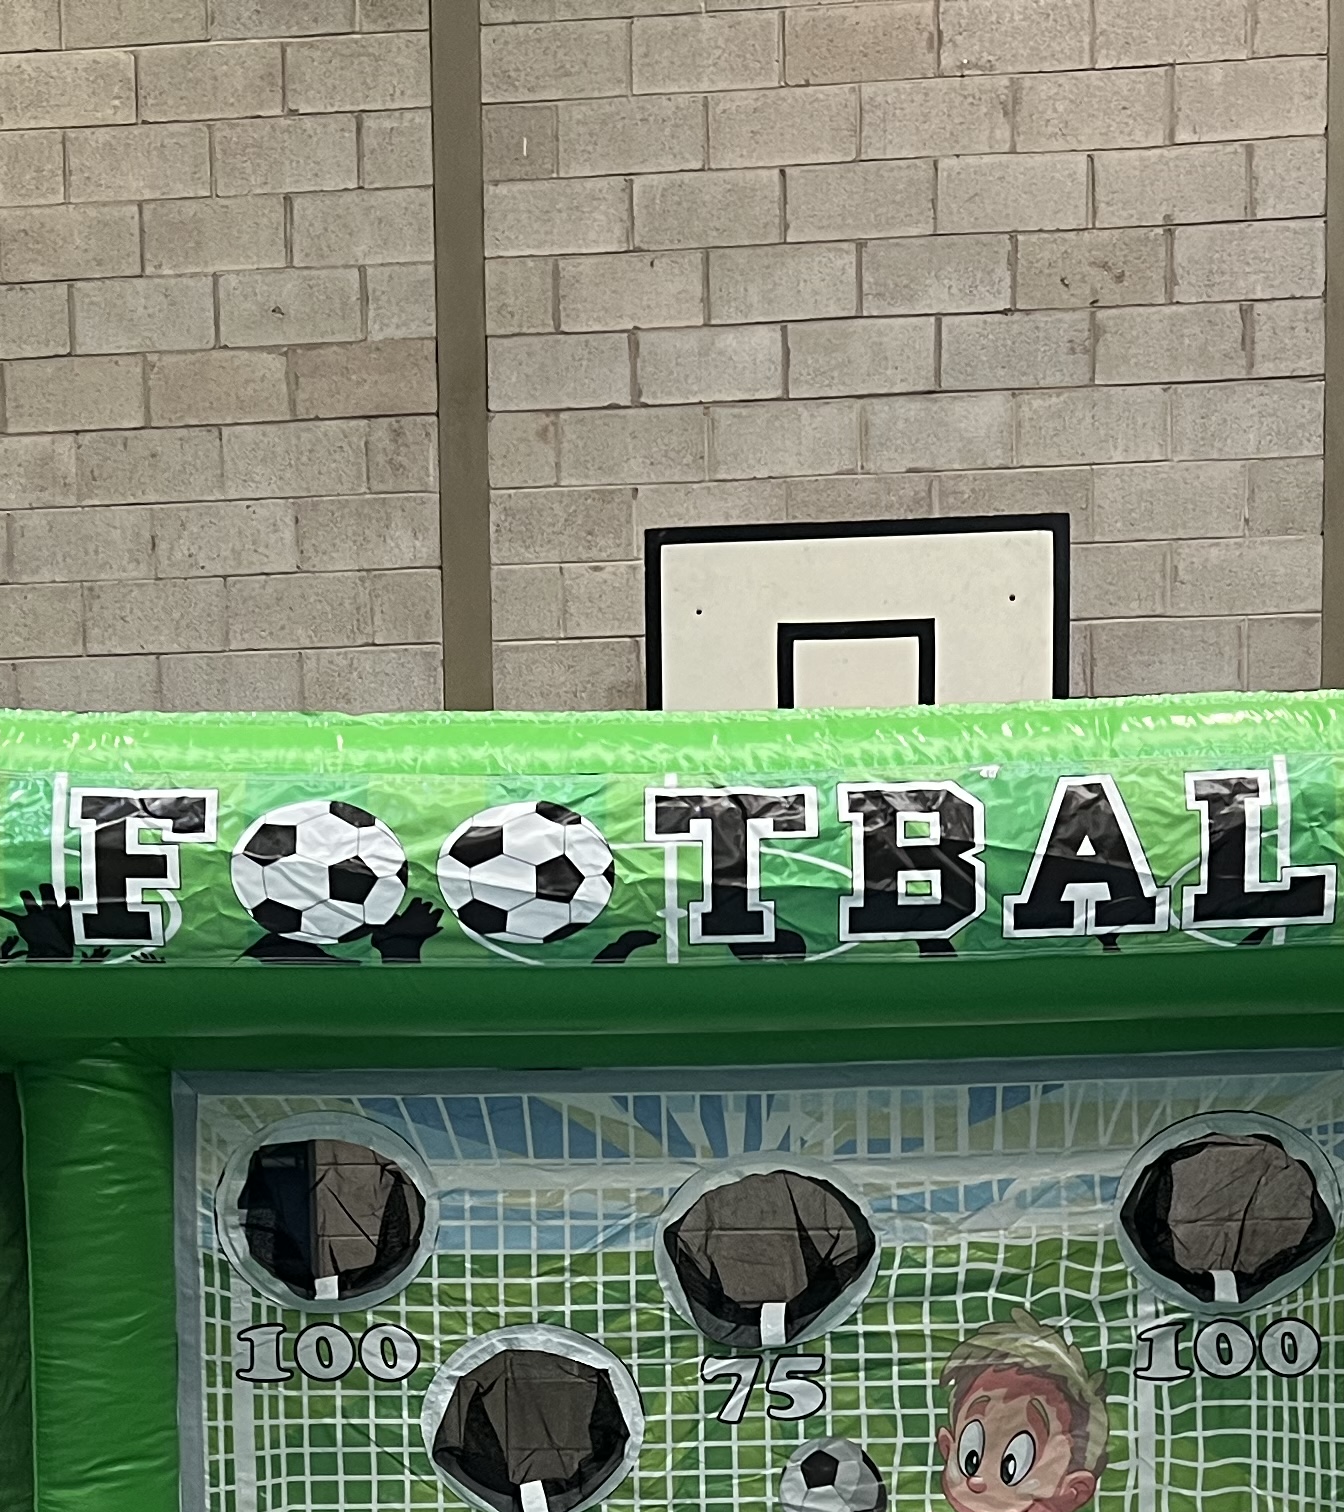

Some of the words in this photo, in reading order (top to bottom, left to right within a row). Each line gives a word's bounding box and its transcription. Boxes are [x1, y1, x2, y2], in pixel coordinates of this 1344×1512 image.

[236, 1321, 421, 1383] 100
[1133, 1317, 1322, 1382] 100
[700, 1353, 827, 1424] 75
